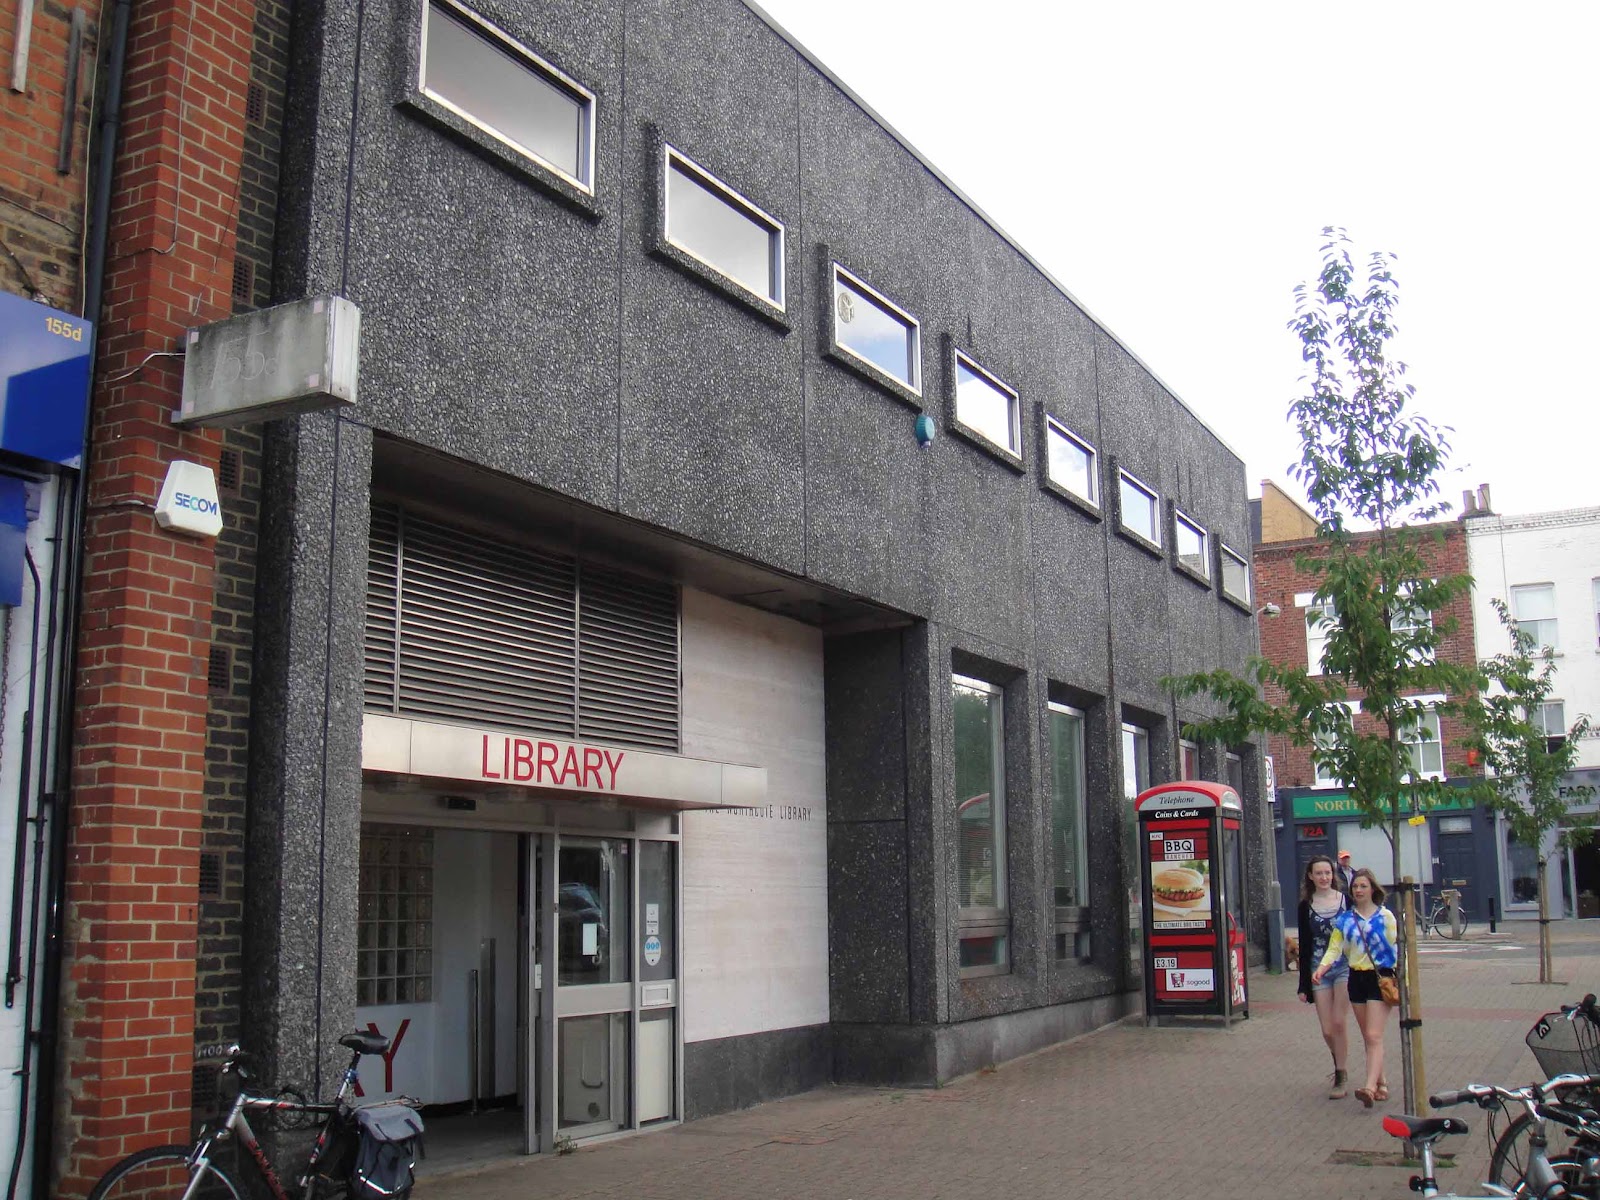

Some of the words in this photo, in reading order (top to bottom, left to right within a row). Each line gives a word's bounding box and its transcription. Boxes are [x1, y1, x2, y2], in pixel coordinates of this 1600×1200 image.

[45, 317, 82, 342] 155d
[175, 492, 217, 515] SECOM
[482, 735, 624, 790] LIBRARY
[1159, 796, 1195, 805] Telephone
[780, 806, 812, 821] LIBRARY
[1303, 826, 1324, 837] 72A
[1165, 840, 1192, 852] BBQ
[1156, 958, 1176, 968] £3.19
